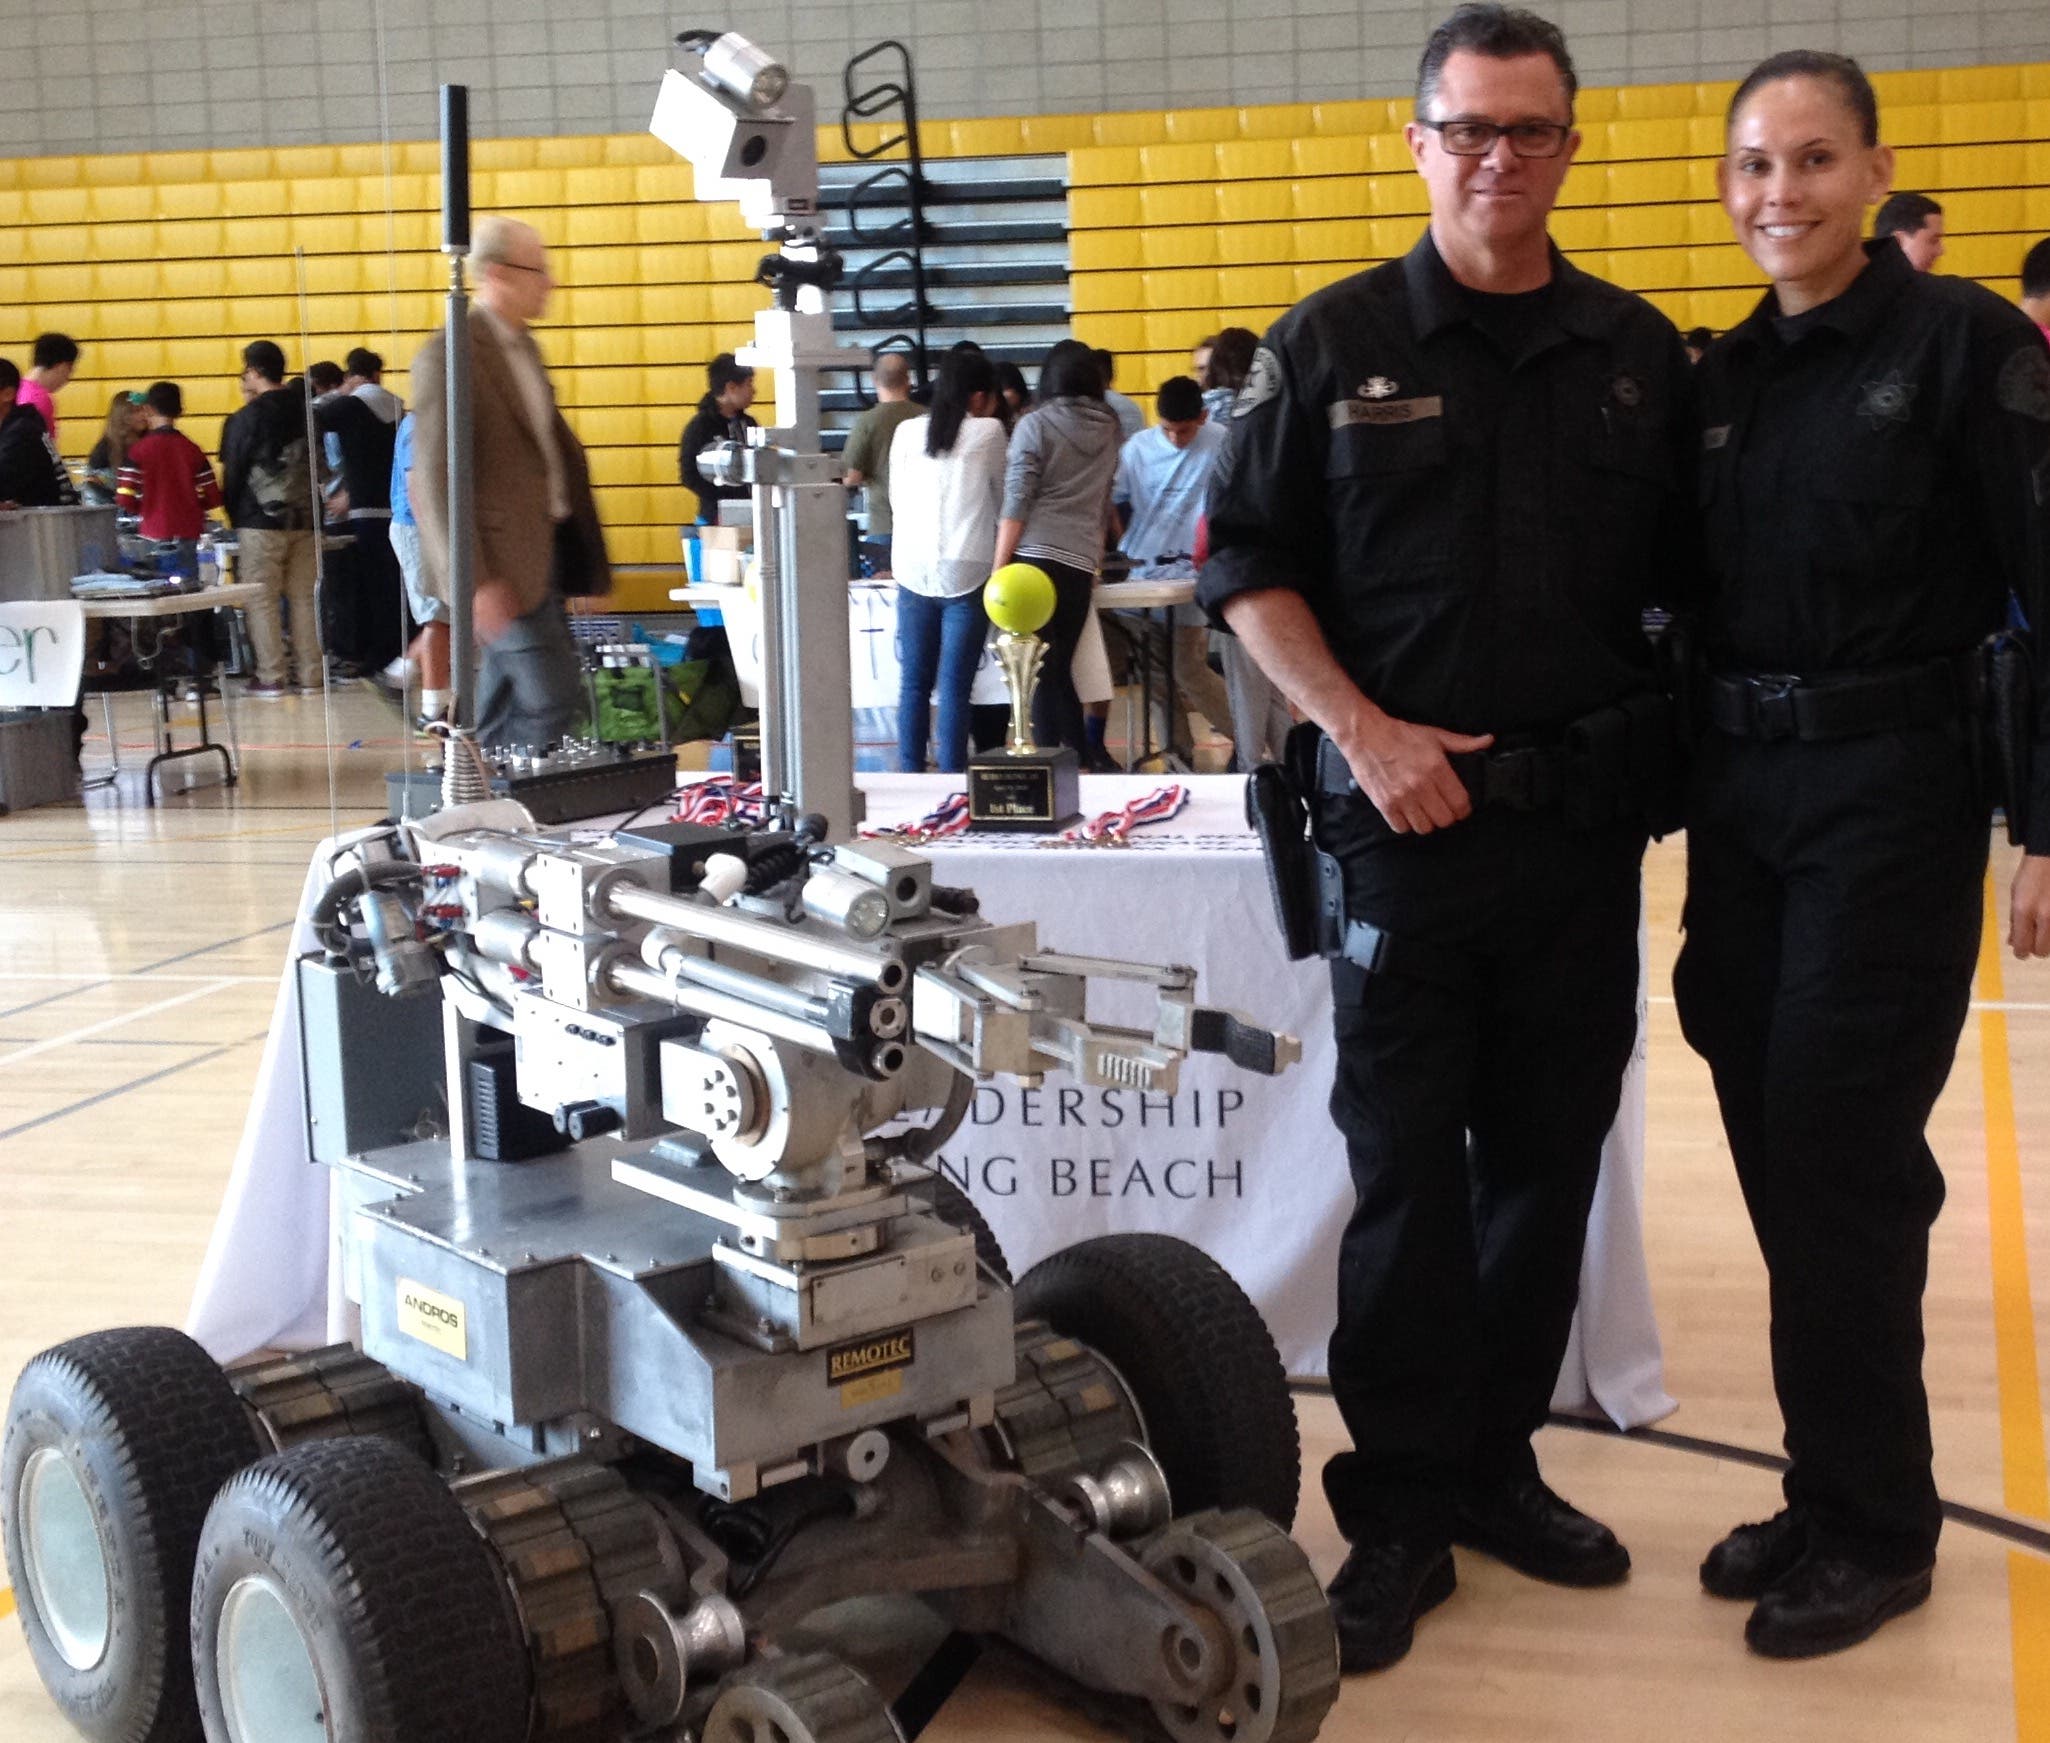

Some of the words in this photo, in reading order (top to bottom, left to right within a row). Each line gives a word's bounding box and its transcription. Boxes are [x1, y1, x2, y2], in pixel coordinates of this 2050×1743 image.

[937, 1154, 1017, 1197] NG
[1051, 1158, 1243, 1199] BEACH
[405, 1294, 458, 1328] ANDROS
[831, 1336, 911, 1373] REMOTEC
